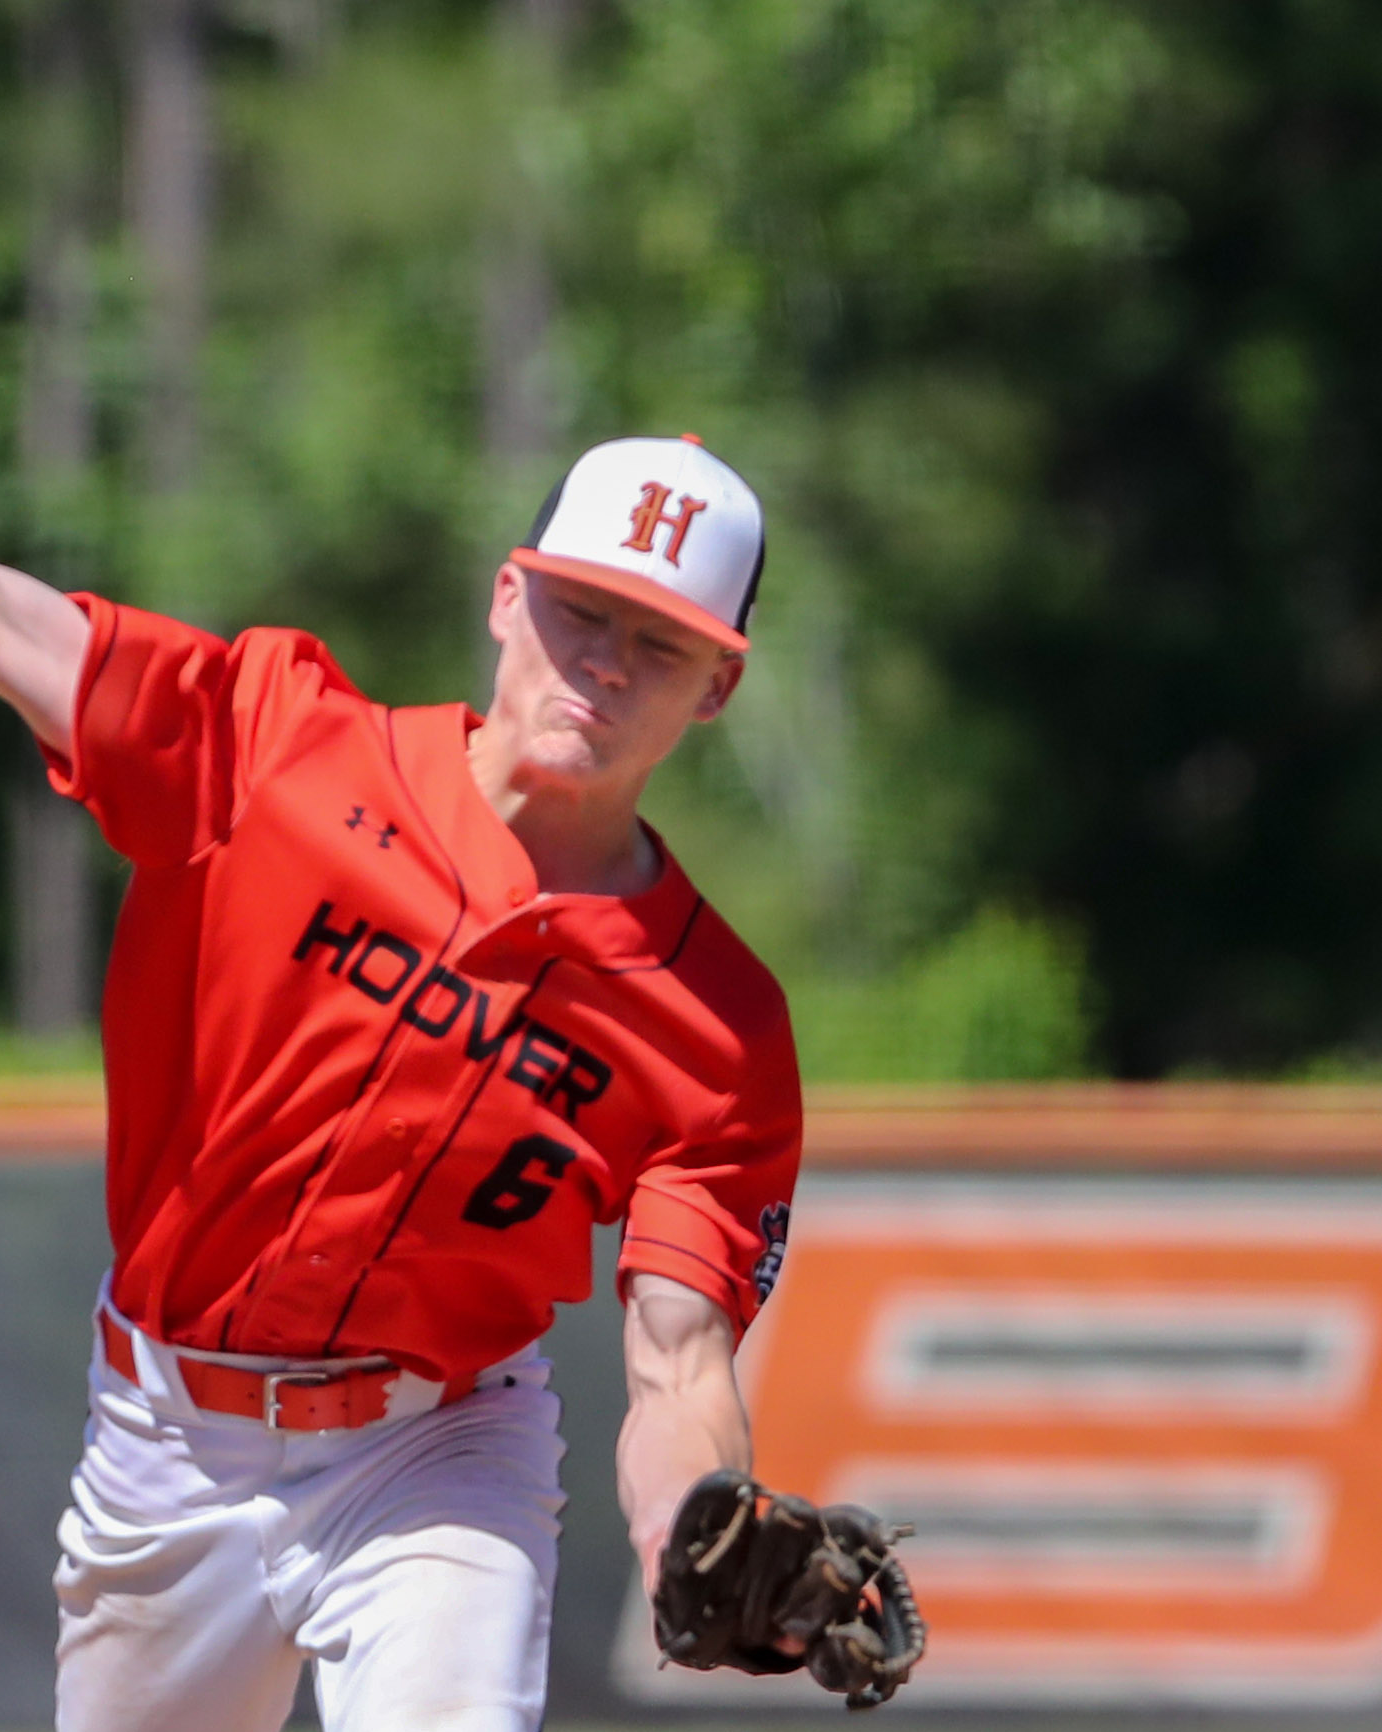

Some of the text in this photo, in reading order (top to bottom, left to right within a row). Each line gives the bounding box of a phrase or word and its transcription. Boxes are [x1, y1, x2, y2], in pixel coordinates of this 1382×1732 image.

[618, 480, 708, 569] H
[292, 898, 613, 1122] HOOVER
[459, 1132, 578, 1231] 6
